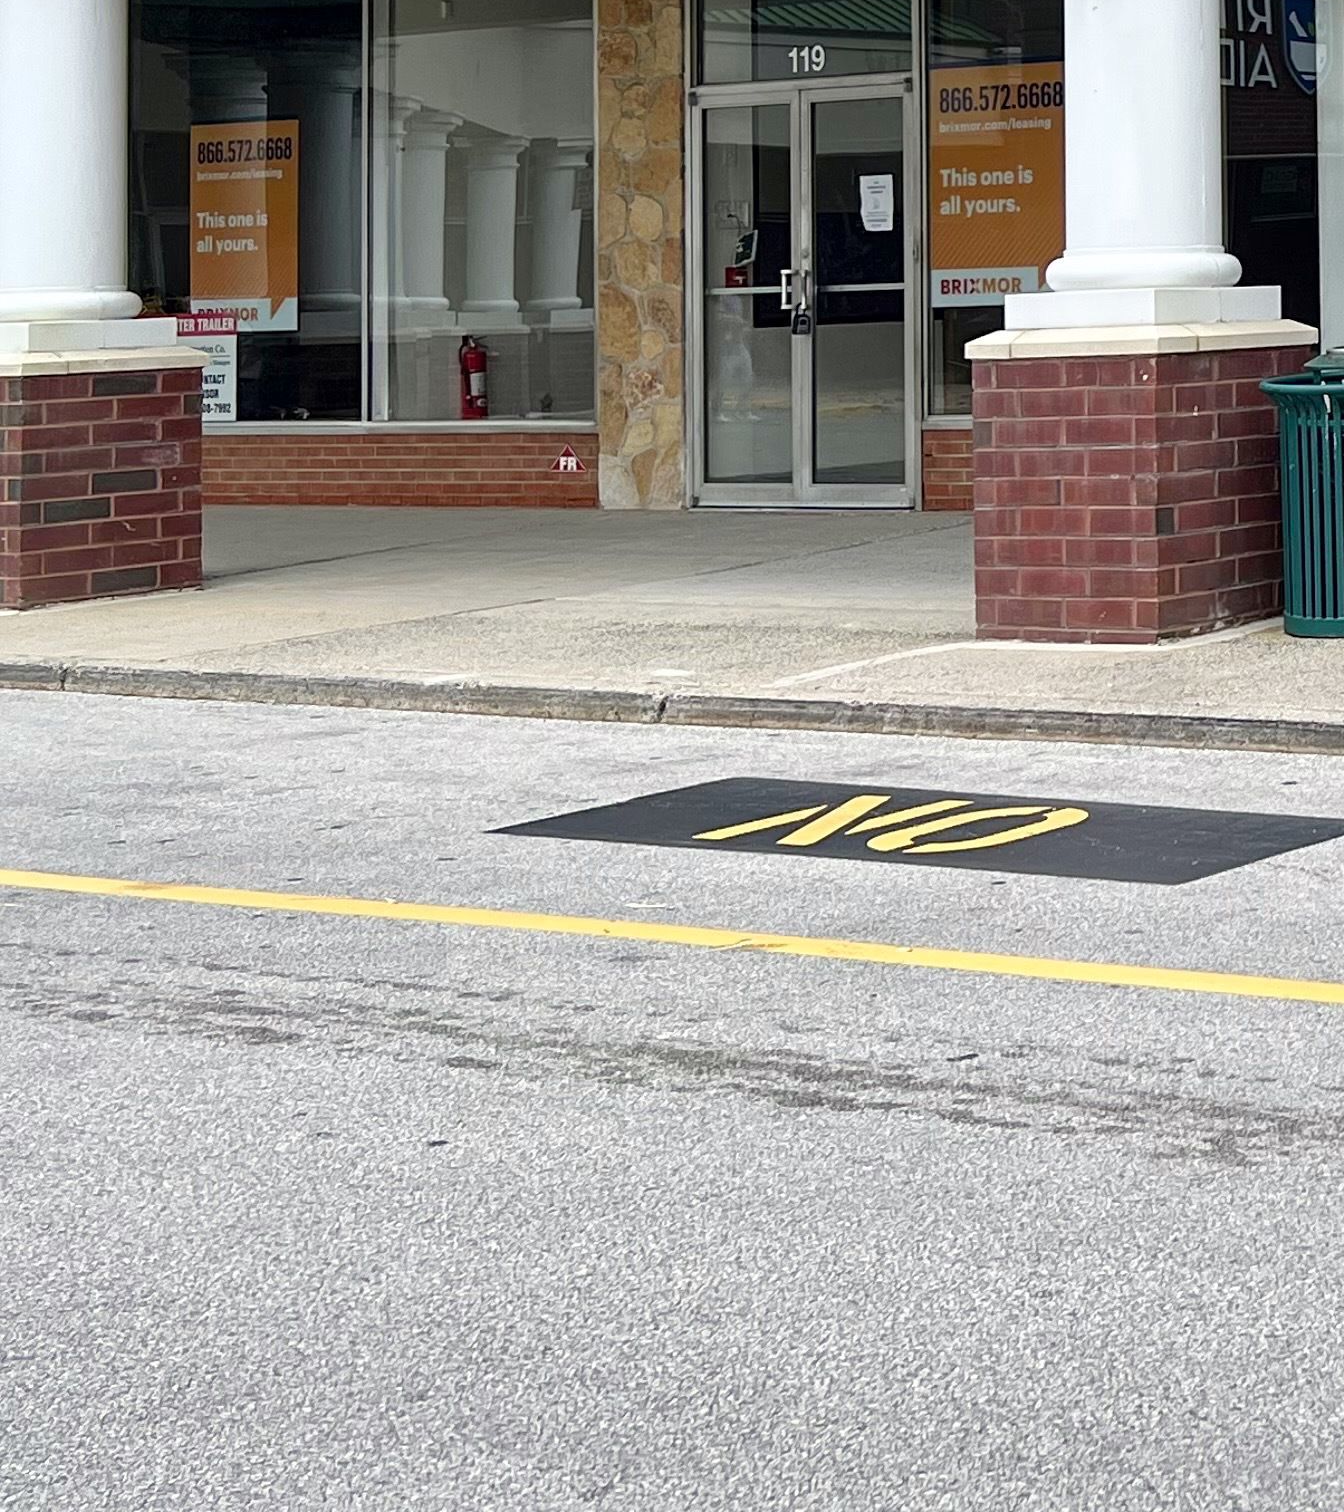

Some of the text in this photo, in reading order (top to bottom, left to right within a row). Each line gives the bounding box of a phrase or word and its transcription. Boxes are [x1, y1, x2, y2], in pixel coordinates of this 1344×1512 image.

[788, 45, 825, 73] 119
[939, 81, 1064, 113] 866.572.6668
[939, 117, 1052, 133] brixmor.com/leasing
[197, 137, 292, 164] 866.572.6668
[940, 165, 1033, 187] This one is
[940, 195, 1021, 217] all yours.
[196, 210, 268, 228] This one is
[196, 237, 258, 255] all yours.
[941, 277, 1022, 295] BRIXMOR
[178, 317, 234, 332] TER TRAILER
[560, 456, 577, 471] FR
[691, 794, 1090, 855] NO
